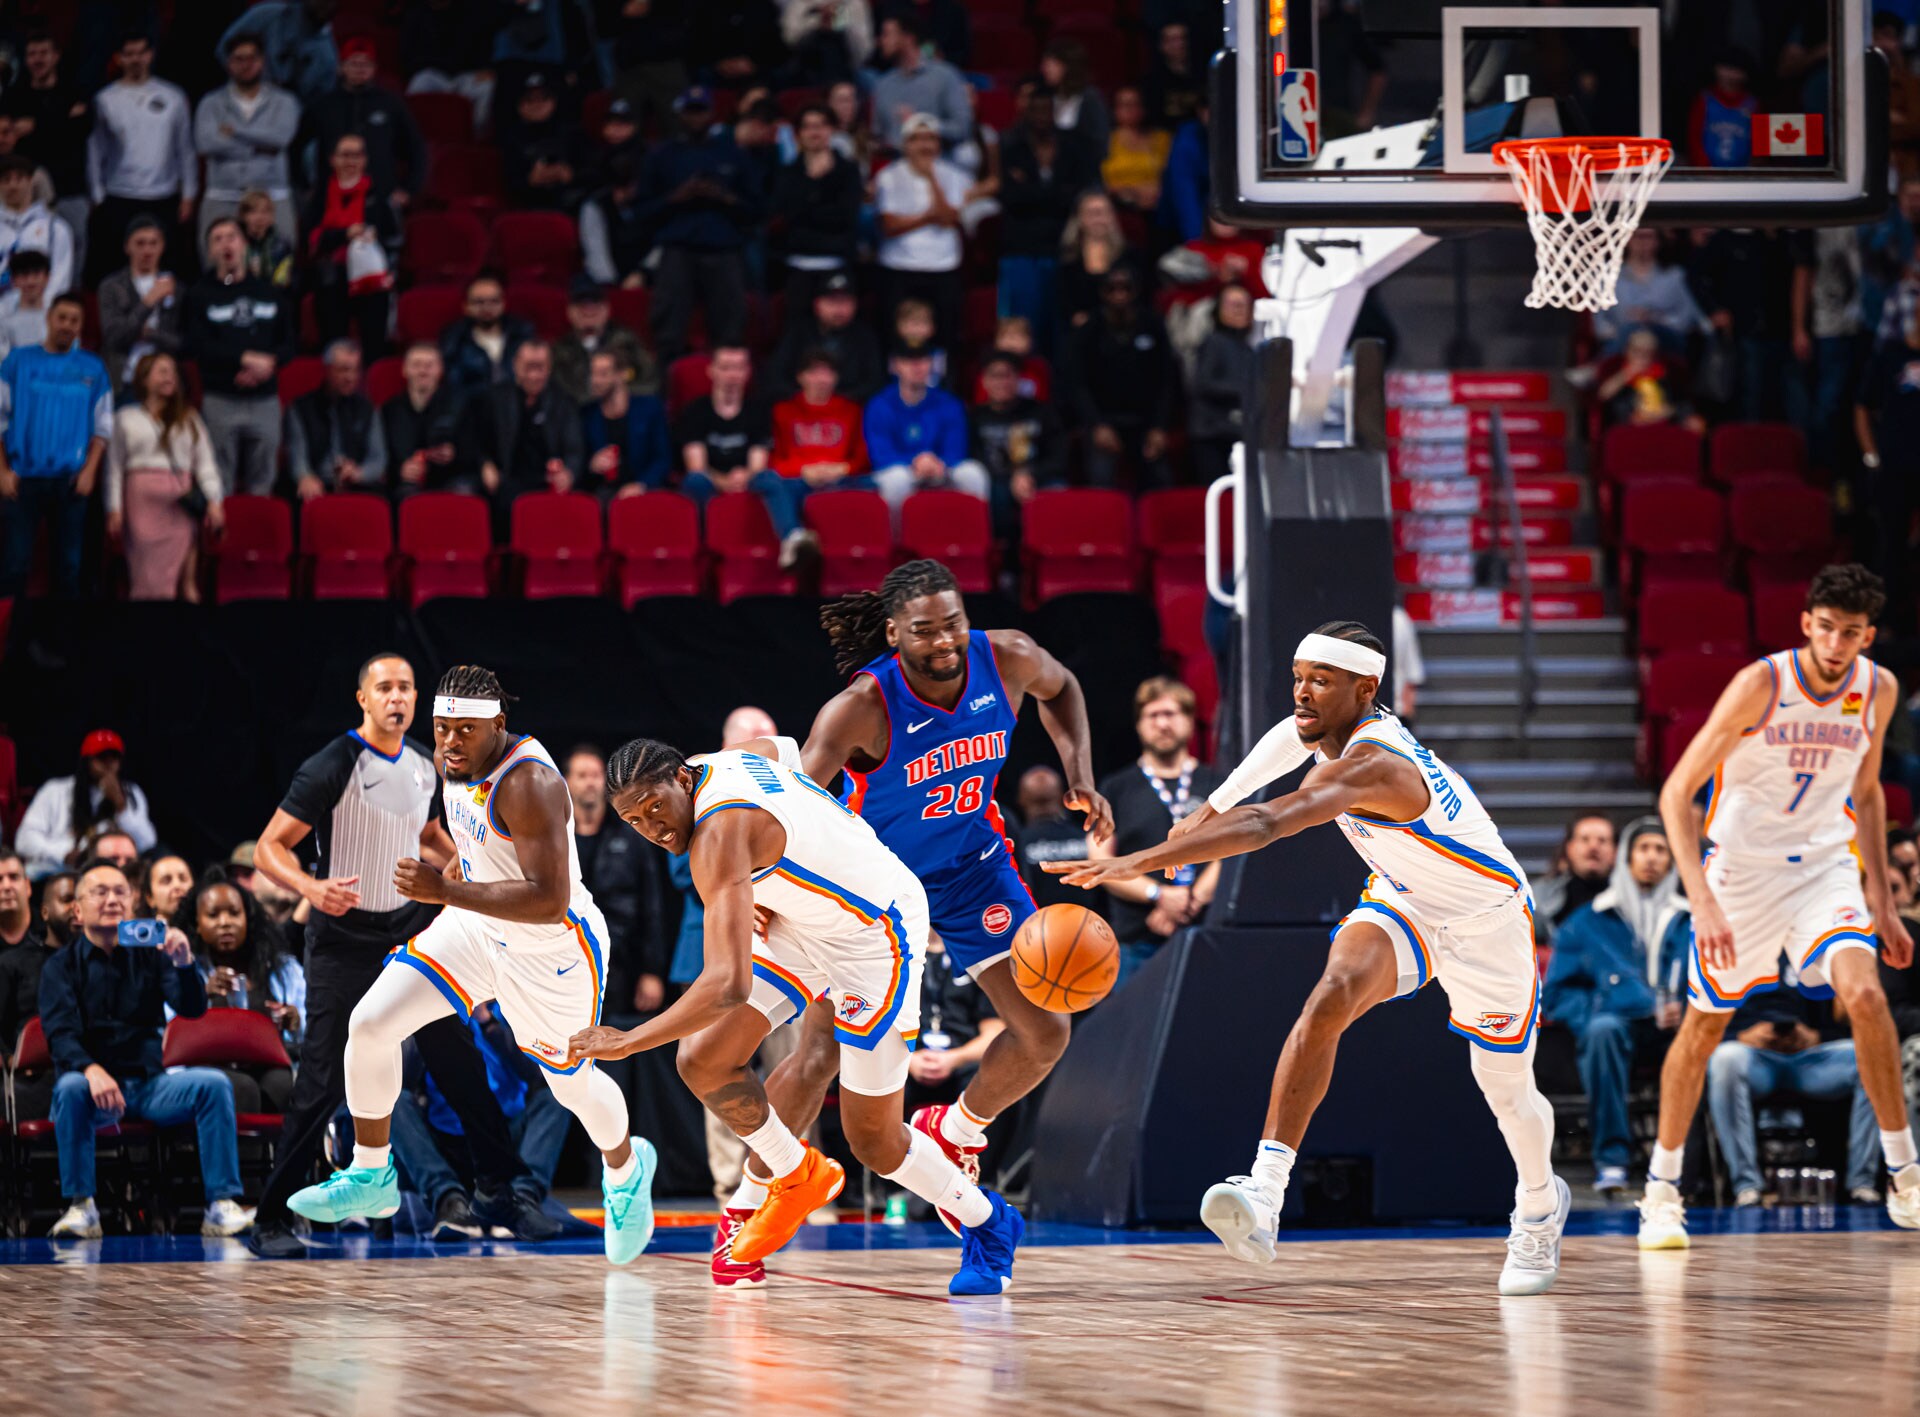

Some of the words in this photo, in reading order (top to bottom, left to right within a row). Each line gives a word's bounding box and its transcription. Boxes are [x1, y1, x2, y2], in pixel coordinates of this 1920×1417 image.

[903, 730, 1007, 787] DETROIT
[1764, 722, 1863, 752] OKLAHOMA
[1788, 746, 1833, 769] CITY
[920, 775, 985, 820] 28
[1783, 772, 1817, 815] 7
